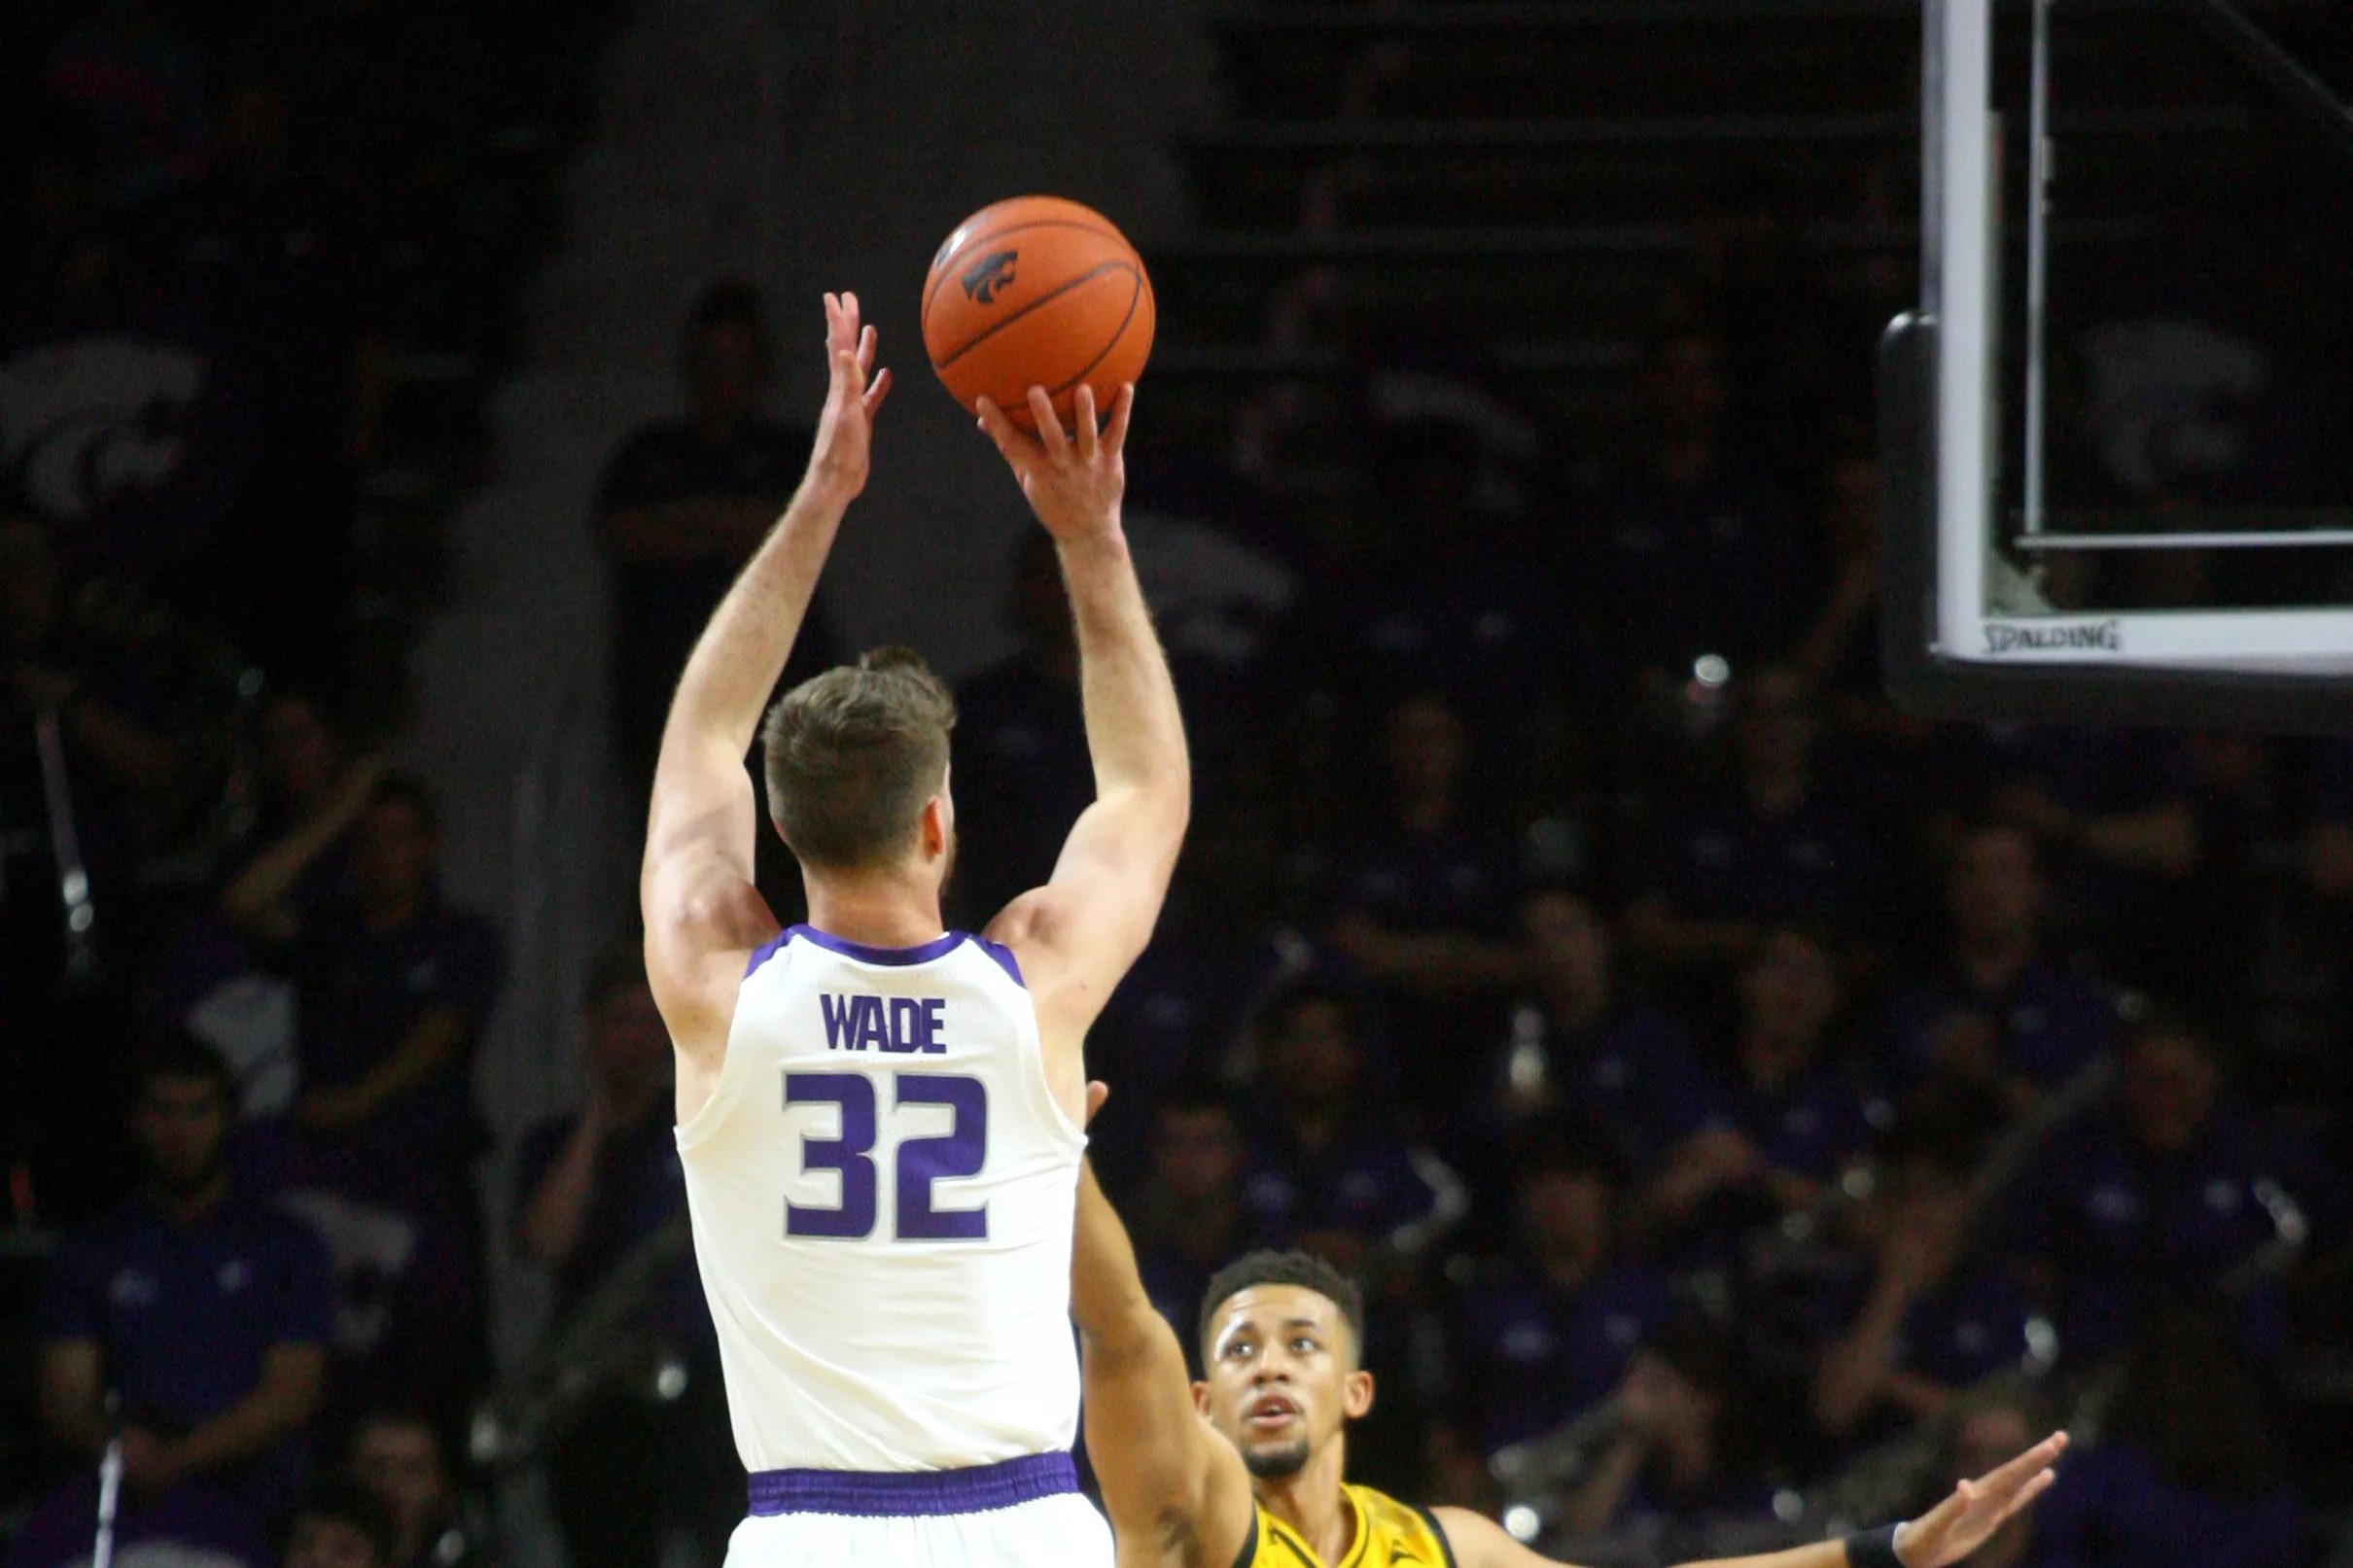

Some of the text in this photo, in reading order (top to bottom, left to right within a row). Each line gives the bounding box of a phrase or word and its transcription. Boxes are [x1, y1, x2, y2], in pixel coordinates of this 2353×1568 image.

[1984, 619, 2118, 653] SPALDING
[820, 993, 947, 1054] WADE
[782, 1069, 990, 1242] 32
